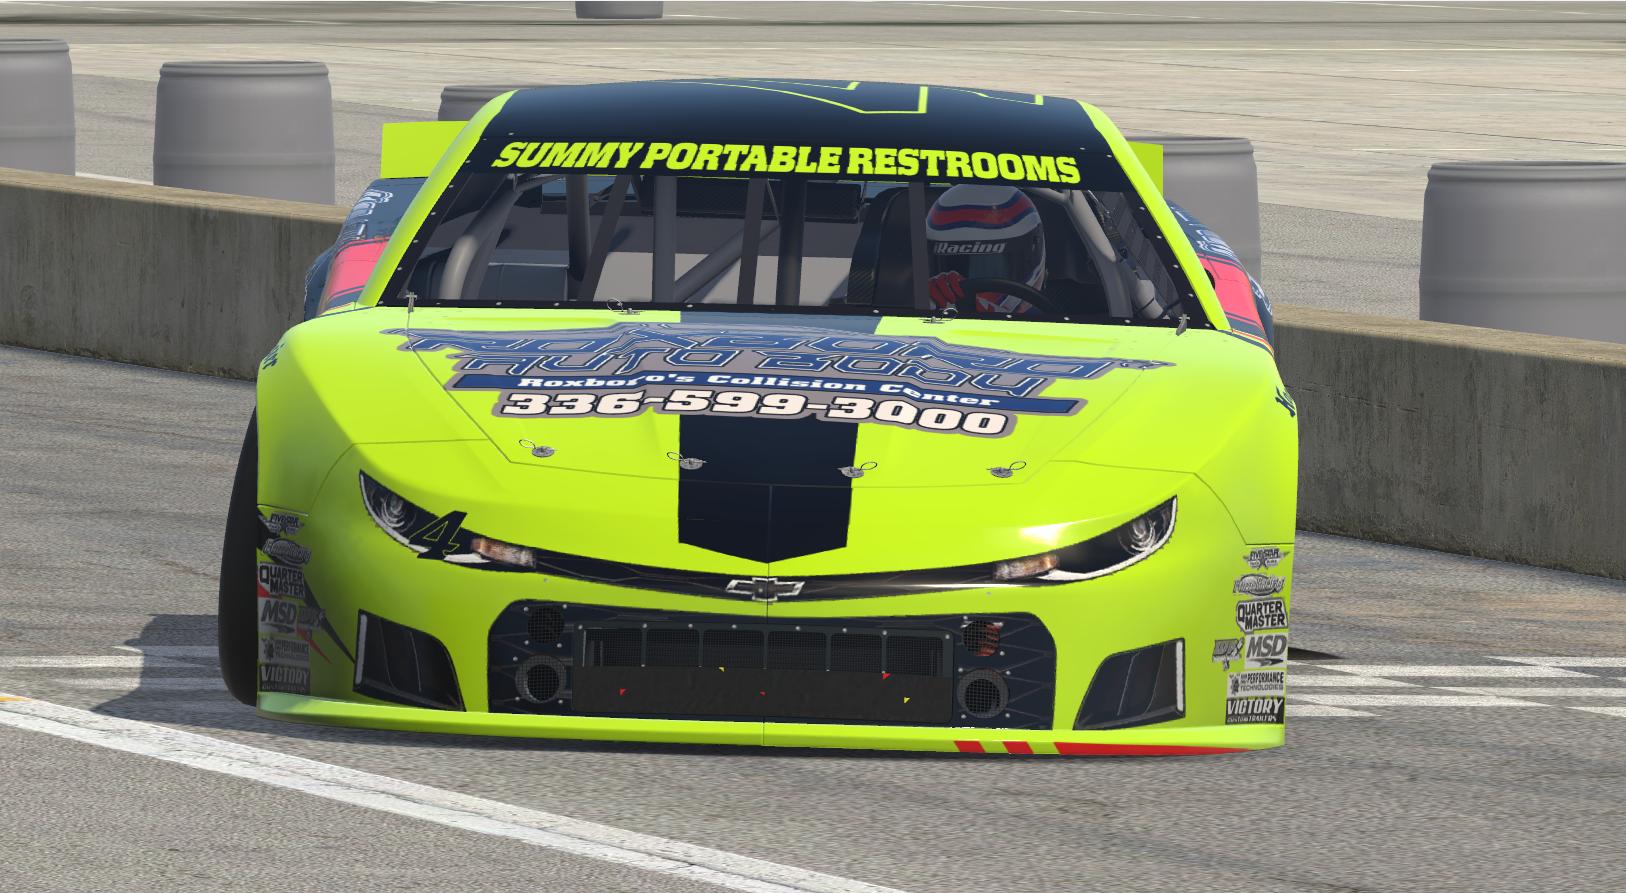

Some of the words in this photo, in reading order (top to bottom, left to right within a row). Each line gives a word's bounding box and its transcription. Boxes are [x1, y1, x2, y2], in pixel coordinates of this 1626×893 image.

[491, 141, 639, 170] SUMMY
[644, 142, 842, 174] PORTABLE
[845, 149, 1082, 185] RESTROOMS
[707, 375, 867, 391] Collision
[879, 384, 1001, 407] Center
[501, 389, 1009, 436] 336-599-3000
[259, 565, 304, 584] QUARTER
[269, 578, 305, 598] MASTER
[260, 599, 298, 626] MSD
[1238, 601, 1283, 622] QUARTER
[1245, 613, 1286, 630] MASTER
[1246, 634, 1287, 658] MSD
[1227, 698, 1284, 715] VICTORY
